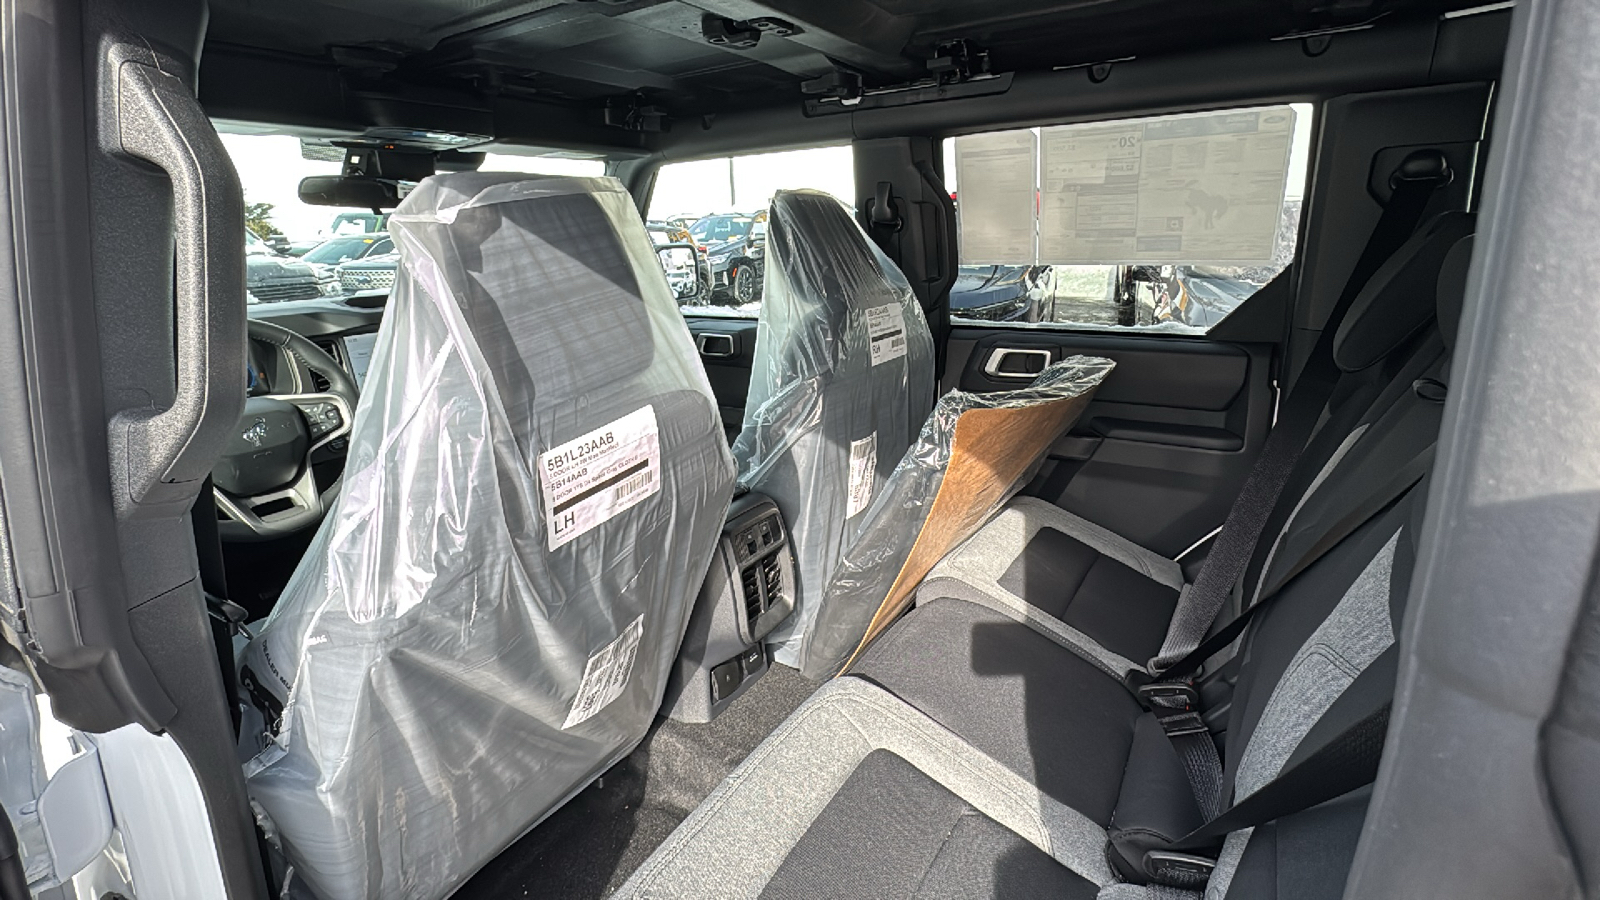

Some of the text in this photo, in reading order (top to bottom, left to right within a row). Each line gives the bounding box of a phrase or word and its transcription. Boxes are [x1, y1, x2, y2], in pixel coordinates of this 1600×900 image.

[547, 431, 614, 471] 5B1L23AAB
[551, 467, 588, 491] 5B14AAB
[554, 511, 575, 535] LH
